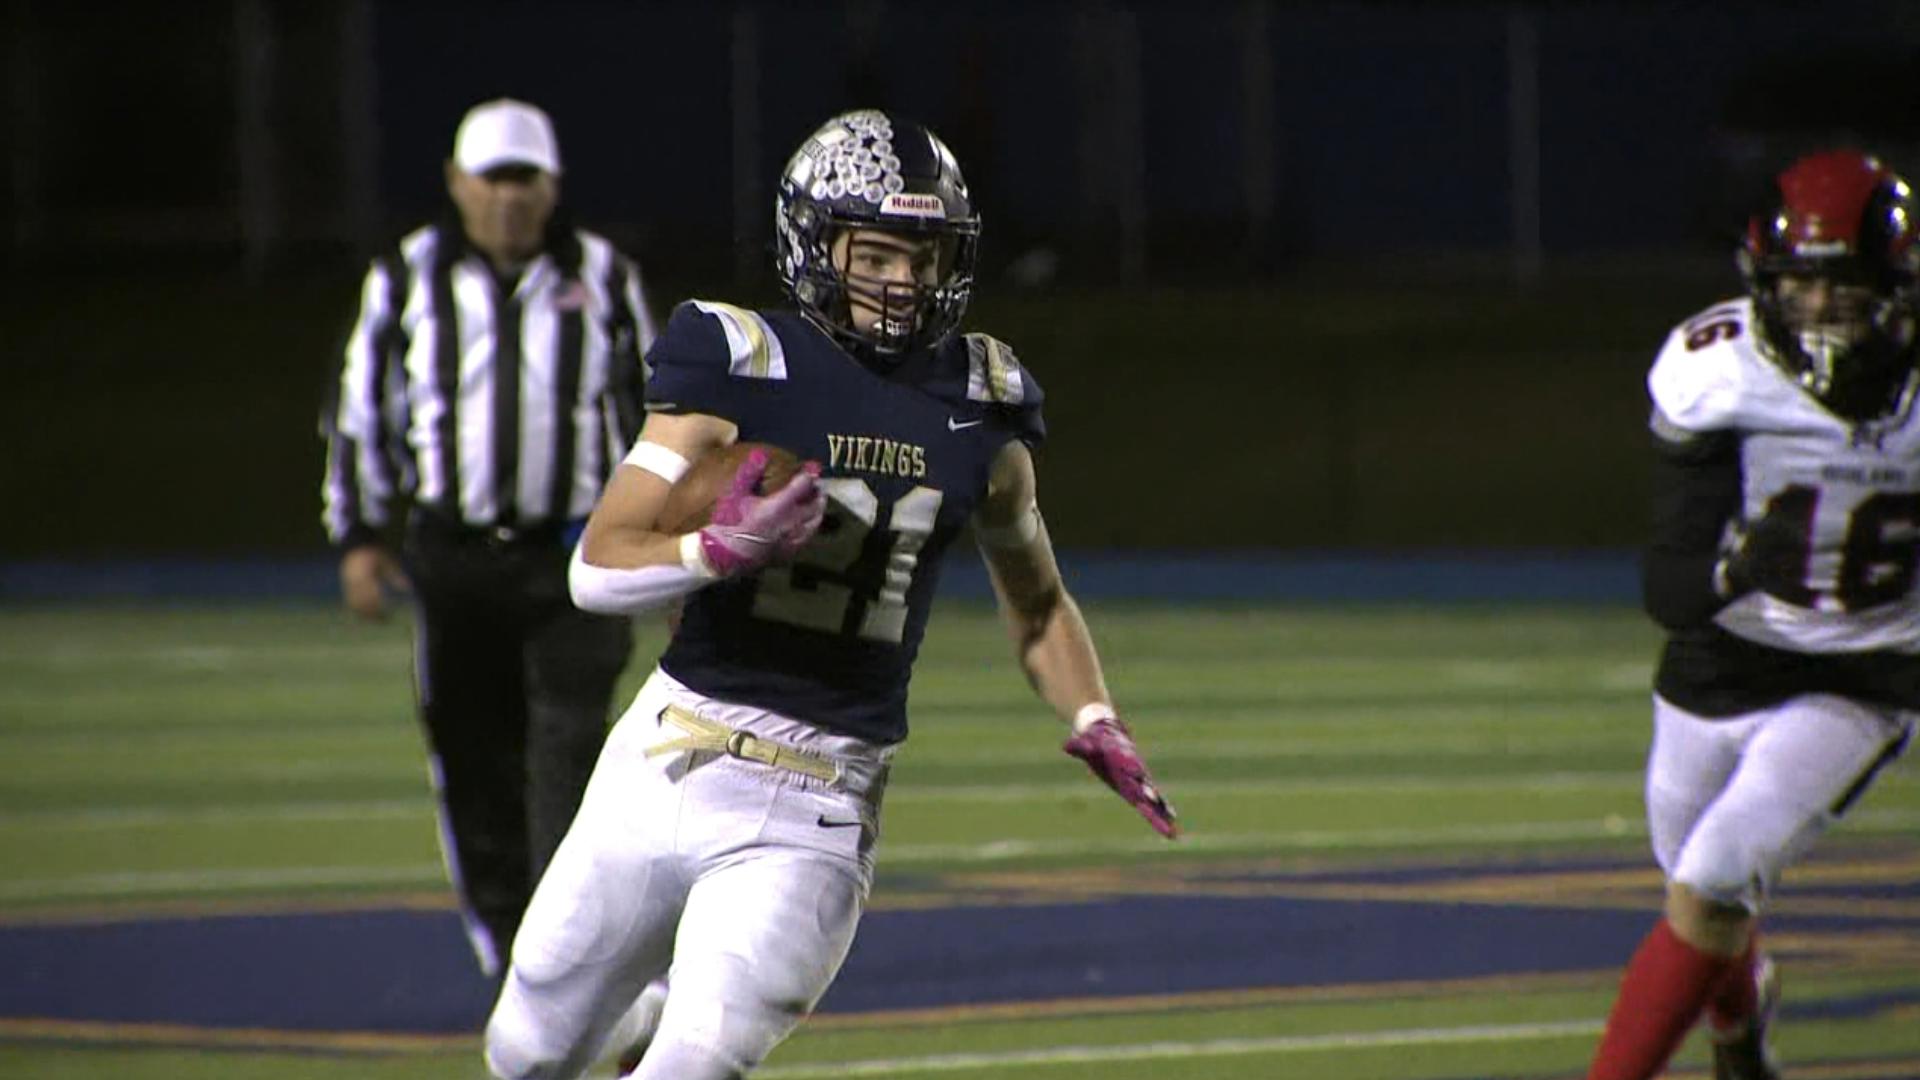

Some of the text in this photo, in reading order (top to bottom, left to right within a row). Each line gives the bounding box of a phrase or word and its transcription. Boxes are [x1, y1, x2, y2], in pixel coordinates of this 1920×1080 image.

[892, 197, 939, 210] Riddell
[827, 434, 926, 477] VIKINGS
[752, 478, 943, 642] 21
[1765, 484, 1920, 614] 16
